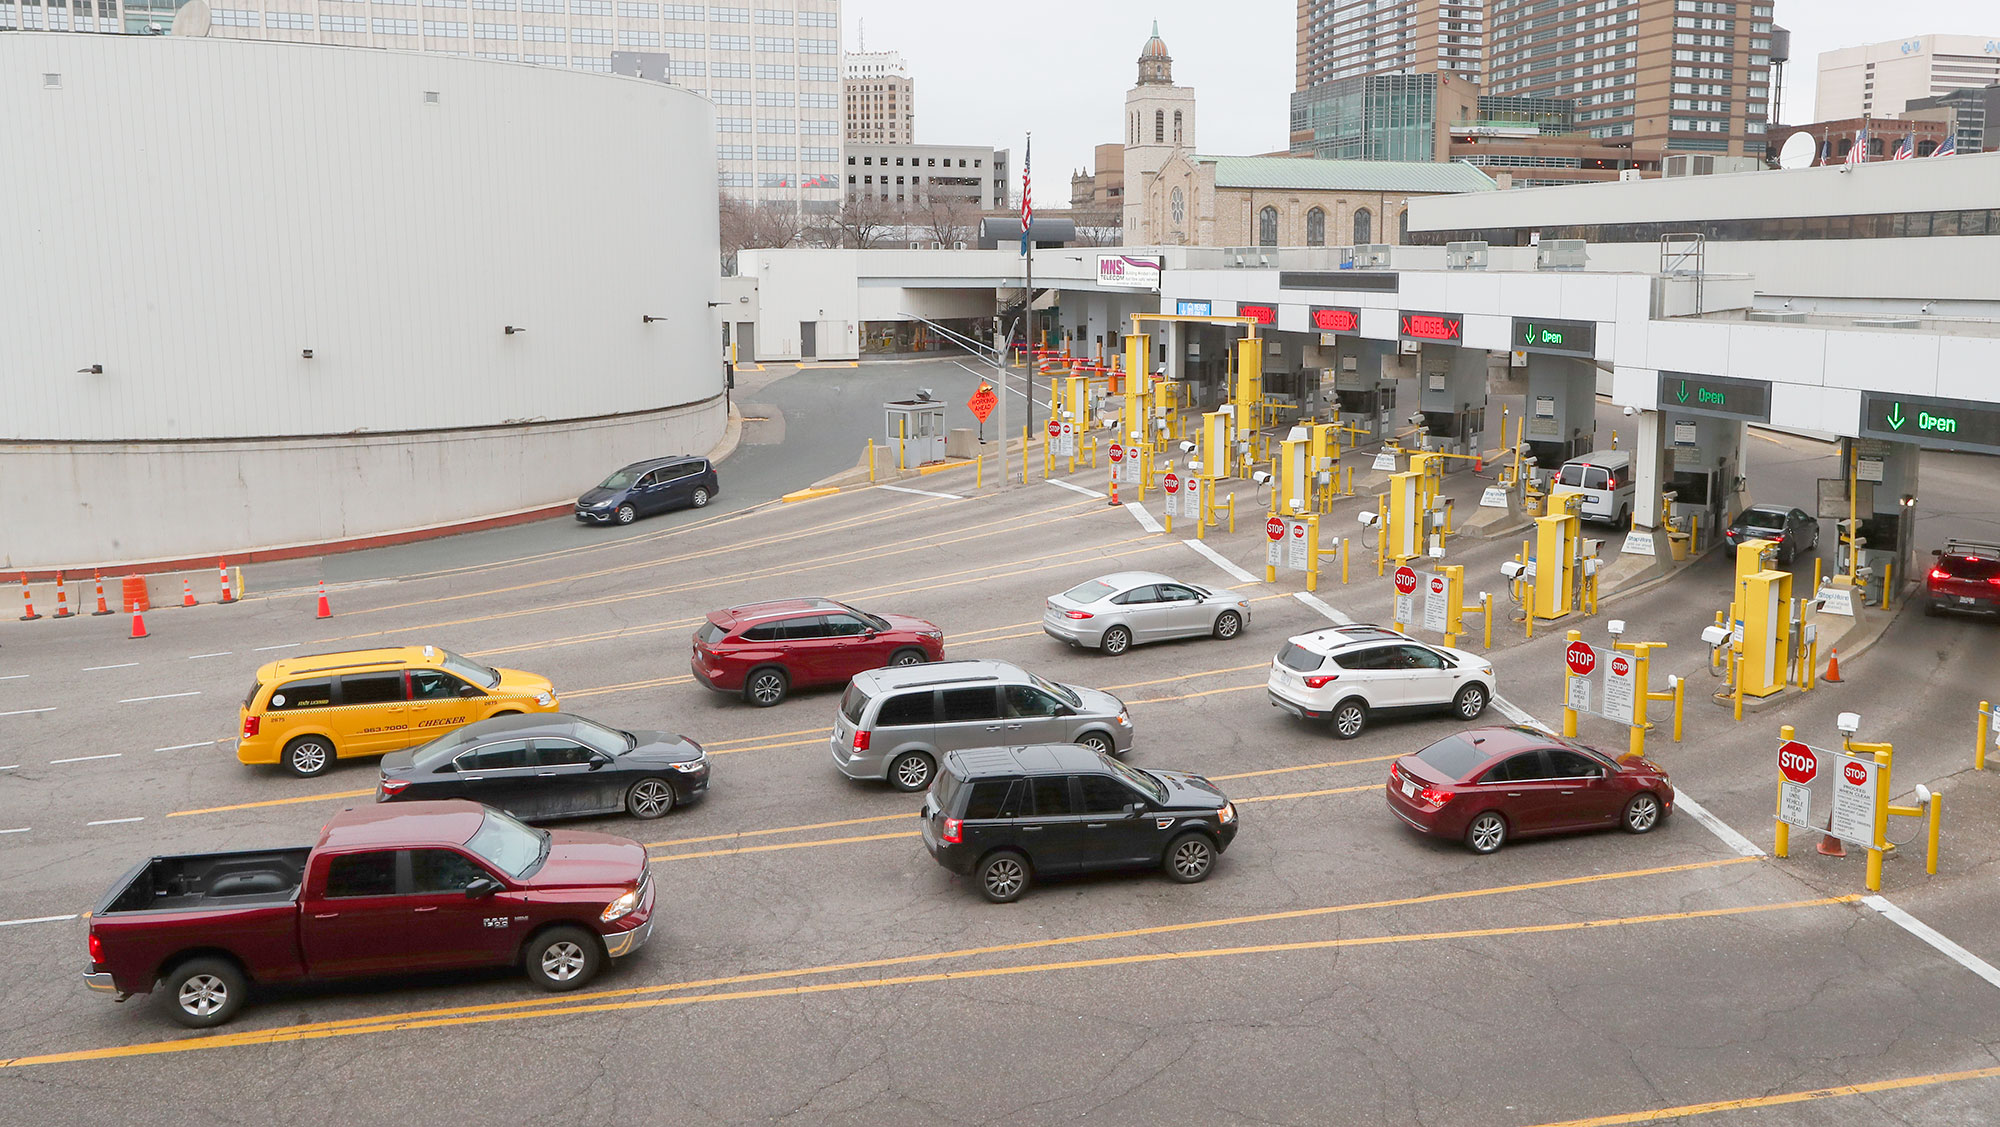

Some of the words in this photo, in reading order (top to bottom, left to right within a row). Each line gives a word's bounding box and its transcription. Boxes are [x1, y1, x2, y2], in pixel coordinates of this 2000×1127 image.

[1101, 260, 1125, 275] MNSi
[1320, 311, 1348, 328] CLOSED
[1542, 330, 1562, 344] Open
[1698, 388, 1725, 405] Open
[1918, 412, 1956, 433] Open
[1110, 449, 1123, 457] STOP
[1165, 479, 1178, 488] STOP
[1268, 524, 1283, 534] STOP
[1396, 574, 1415, 587] STOP
[1568, 650, 1593, 666] STOP
[1613, 662, 1628, 672] STOP
[418, 716, 465, 728] CHECKER
[364, 724, 408, 733] 963.7000
[1781, 751, 1814, 773] STOP
[1845, 767, 1865, 780] STOP
[1843, 785, 1866, 793] PROCEED
[1786, 798, 1803, 807] VEHICLE
[1788, 804, 1801, 812] AHEAD
[1783, 815, 1804, 825] RELEASED
